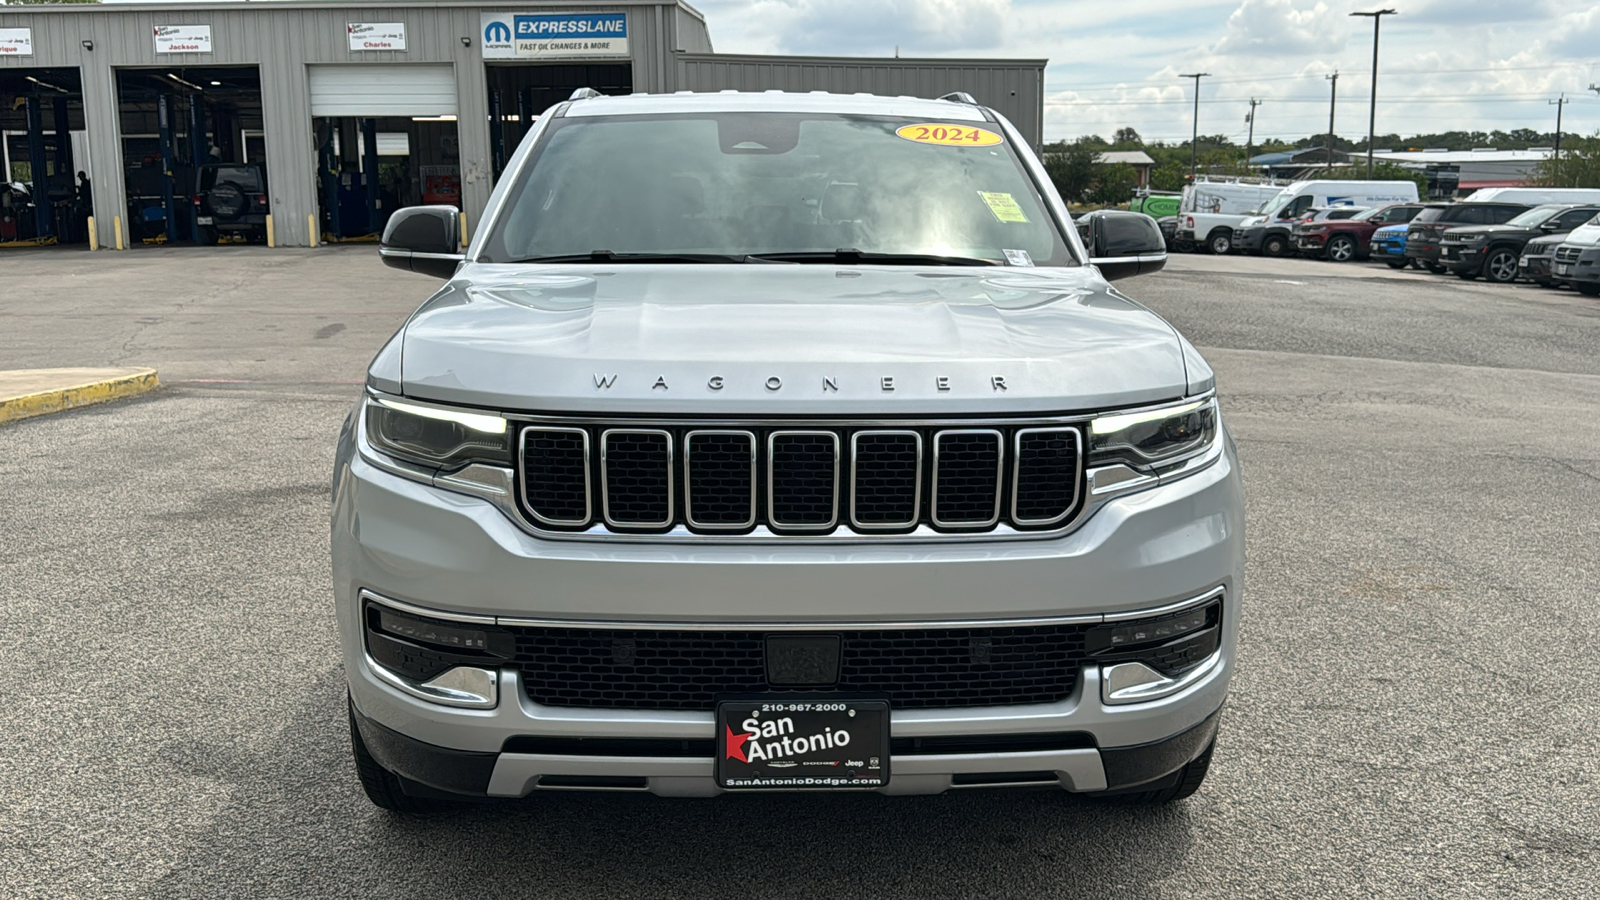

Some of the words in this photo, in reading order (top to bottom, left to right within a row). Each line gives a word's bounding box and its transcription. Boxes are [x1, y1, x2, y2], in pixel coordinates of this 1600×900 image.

[517, 20, 624, 33] EXPRESSLANE
[915, 127, 980, 142] 2024
[593, 373, 1008, 391] WAGONEER
[742, 717, 794, 741] San
[747, 727, 850, 763] Antonio
[726, 778, 881, 786] SanAntonioDodge.com
